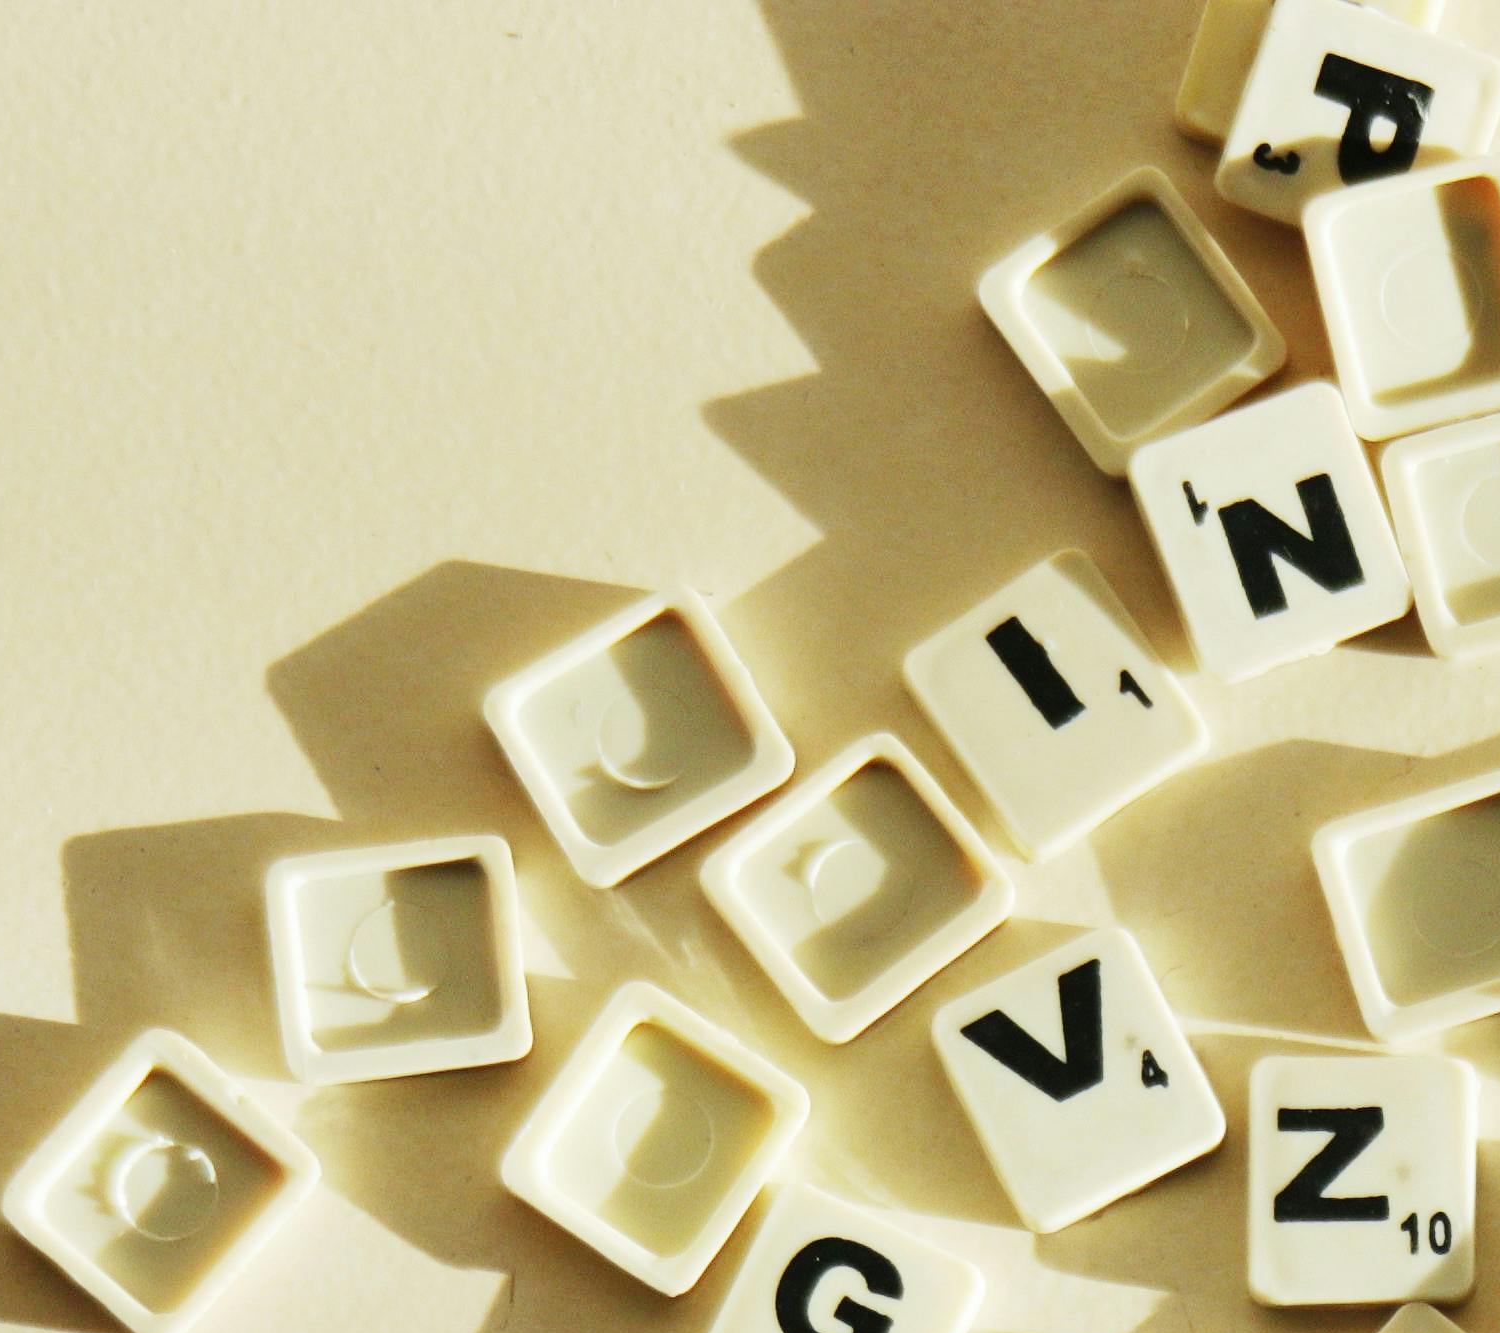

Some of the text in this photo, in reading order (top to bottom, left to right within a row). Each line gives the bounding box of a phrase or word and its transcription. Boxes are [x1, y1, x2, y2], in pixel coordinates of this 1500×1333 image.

[1253, 53, 1435, 185] P 3
[1183, 474, 1364, 618] N 1
[986, 617, 1152, 729] I 1
[960, 959, 1168, 1101] V 4
[1274, 1107, 1452, 1255] Z 10
